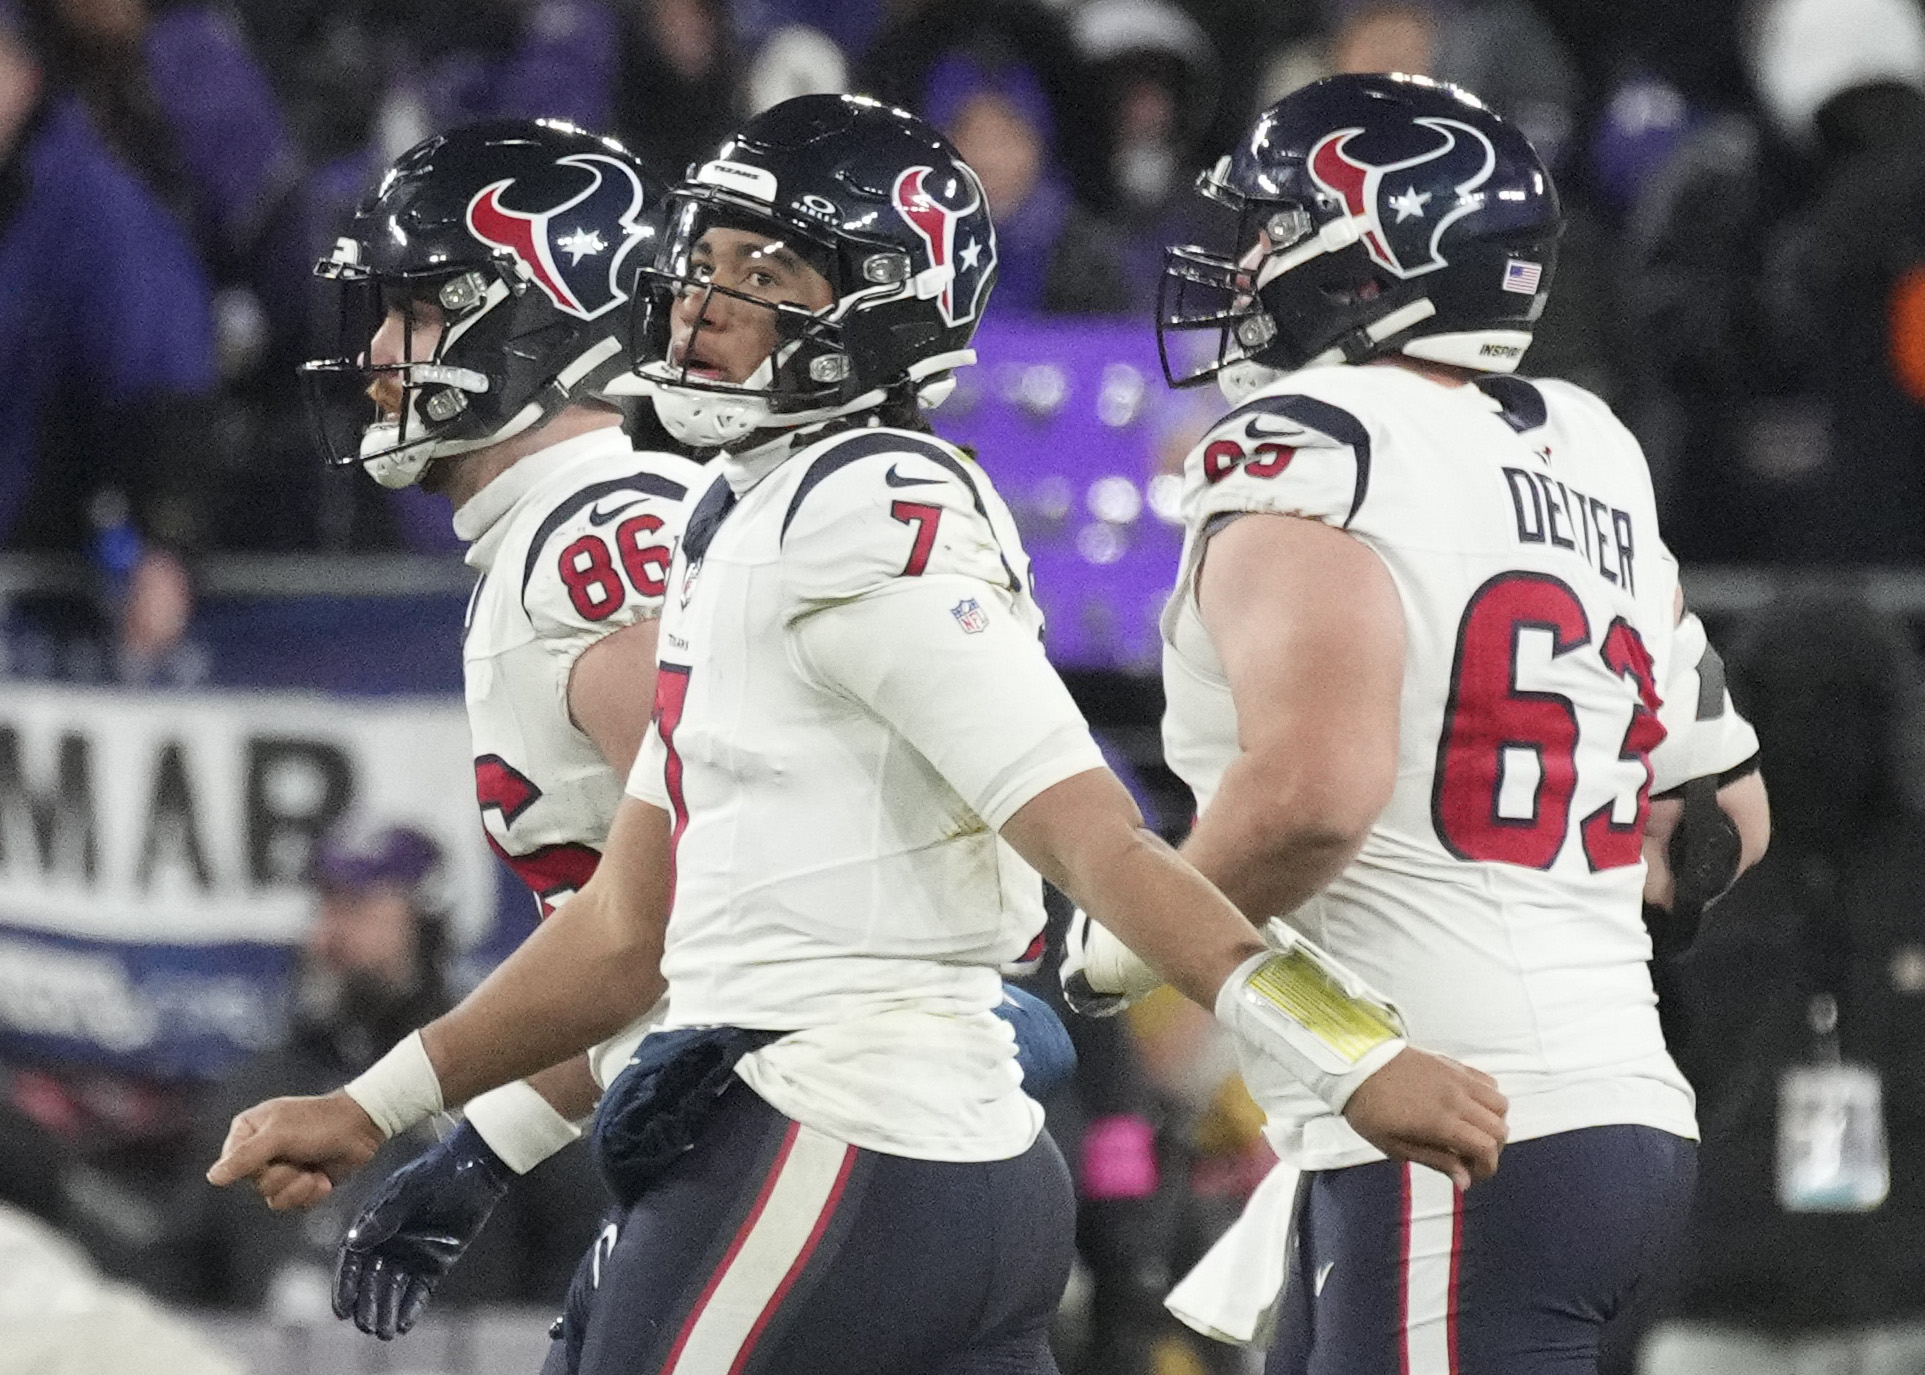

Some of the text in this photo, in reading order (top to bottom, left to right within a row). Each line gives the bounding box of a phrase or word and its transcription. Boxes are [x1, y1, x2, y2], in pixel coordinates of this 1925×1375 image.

[557, 514, 672, 622] 86
[891, 499, 942, 577] 7
[1501, 466, 1635, 600] DEITER
[1430, 570, 1668, 875] 63
